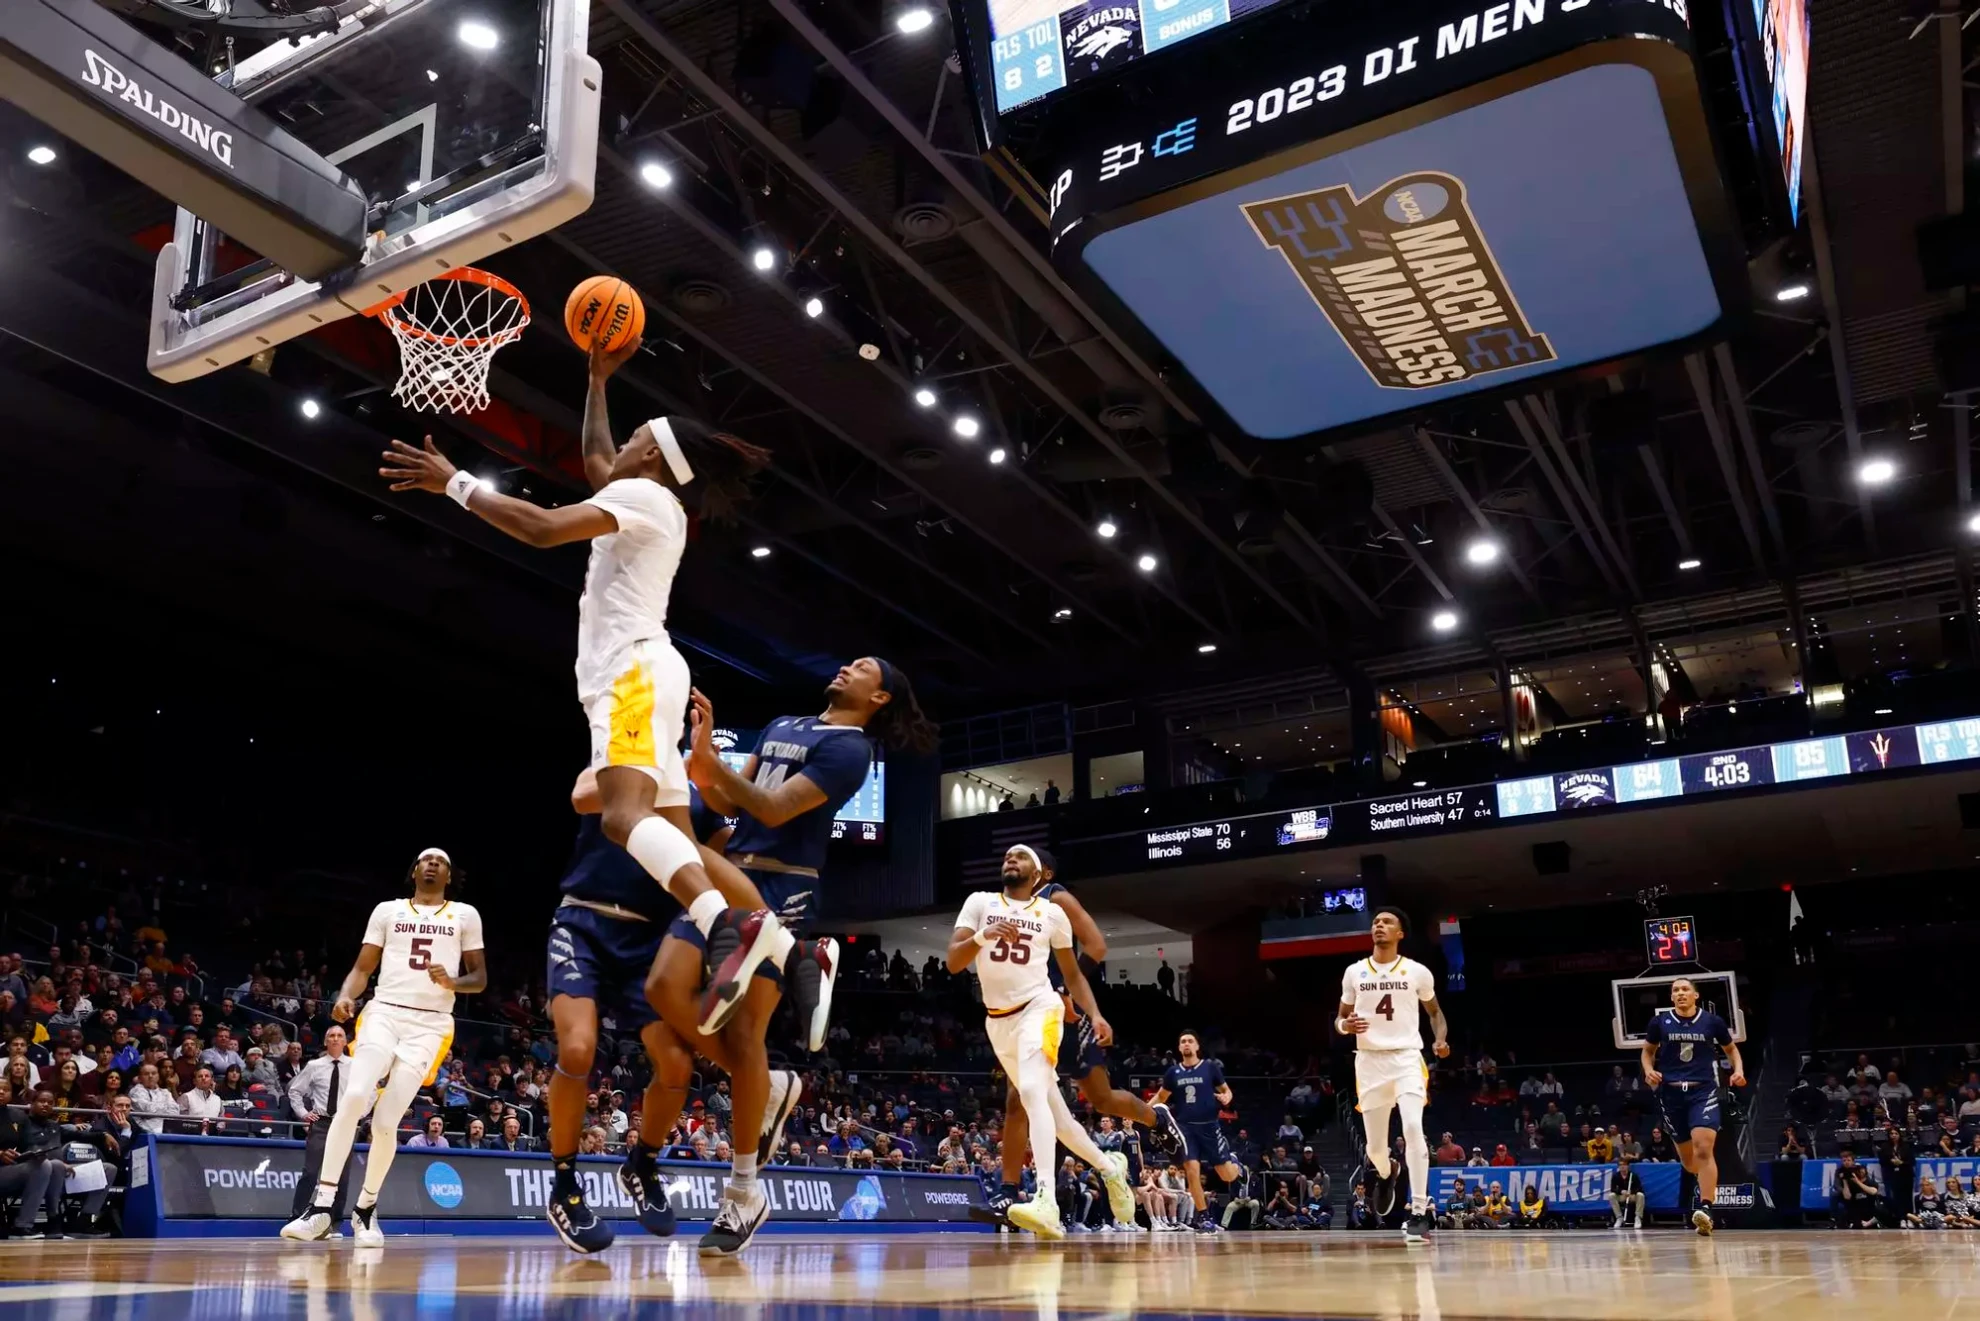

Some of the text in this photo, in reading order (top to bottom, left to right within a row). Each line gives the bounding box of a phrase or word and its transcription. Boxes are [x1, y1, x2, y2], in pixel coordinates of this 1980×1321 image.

[1066, 7, 1137, 48] NEVADA
[1159, 8, 1214, 40] BONUS
[994, 21, 1056, 63] FLS TOL
[1004, 54, 1053, 91] 8 2
[1226, 64, 1347, 136] 2023
[1363, 36, 1420, 87] DI
[81, 48, 234, 169] SPALDING
[1394, 189, 1424, 224] NCAA
[1390, 219, 1509, 333] MARCH
[579, 298, 602, 335] NCAA
[1330, 256, 1466, 386] MADNESS
[1712, 754, 1737, 766] 2ND
[1560, 773, 1609, 792] NEVADA
[1633, 762, 1662, 789] 64
[1705, 762, 1750, 787] 4:03
[1291, 810, 1317, 824] WBB
[1369, 792, 1463, 815] Sacred Heart 57
[1474, 808, 1492, 818] 0:14
[1370, 808, 1464, 831] Southern University 47
[1147, 823, 1231, 845] Mississippi State 70
[1148, 838, 1231, 859] Illinois 56
[394, 922, 455, 937] SUN DEVILS
[408, 937, 433, 971] 5
[990, 933, 1033, 965] 35
[1360, 981, 1408, 991] SUN DEVILS
[1375, 994, 1394, 1021] 4
[1185, 1085, 1196, 1103] 2
[783, 1179, 836, 1212] FOUR
[924, 1191, 970, 1205] POWERADE
[1715, 1186, 1737, 1196] ARCH
